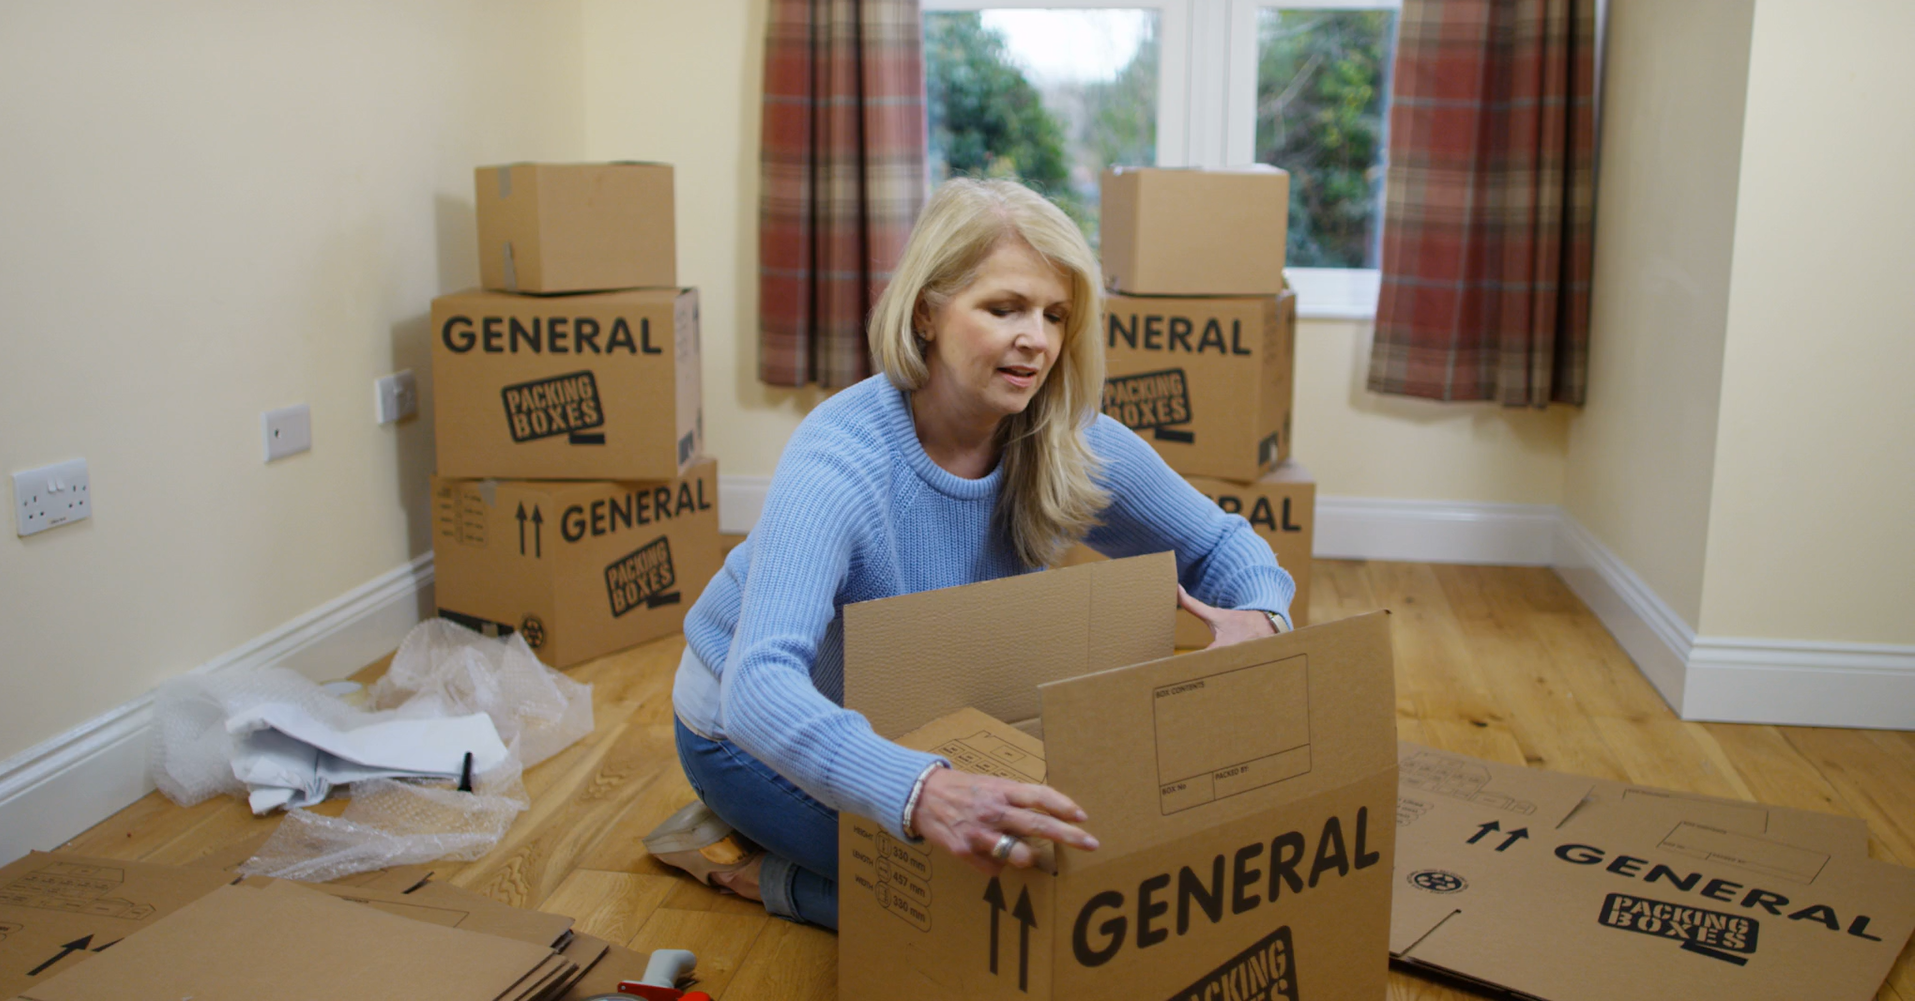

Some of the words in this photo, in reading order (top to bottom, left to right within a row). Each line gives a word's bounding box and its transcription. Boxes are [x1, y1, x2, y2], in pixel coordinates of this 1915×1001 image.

[441, 315, 663, 355] GENERAL
[1106, 312, 1252, 356] NERAL
[506, 375, 593, 414] PACKING
[1104, 374, 1183, 407] PACKING
[512, 400, 598, 439] BOXES
[561, 477, 712, 544] GENERAL
[607, 541, 667, 590] PACKING
[613, 563, 672, 613] BOXES
[1156, 689, 1170, 698] BOX
[1162, 786, 1176, 795] BOX
[893, 846, 909, 862] 330
[910, 858, 926, 873] mm
[893, 871, 908, 887] 457
[910, 882, 926, 898] mm
[1072, 805, 1381, 967] GENERAL
[1554, 844, 1882, 942] GENERAL
[893, 895, 909, 912] 330
[910, 907, 926, 923] mm
[1611, 896, 1750, 935] PACKING
[1607, 910, 1747, 949] BOXES
[1190, 939, 1287, 1001] CKING
